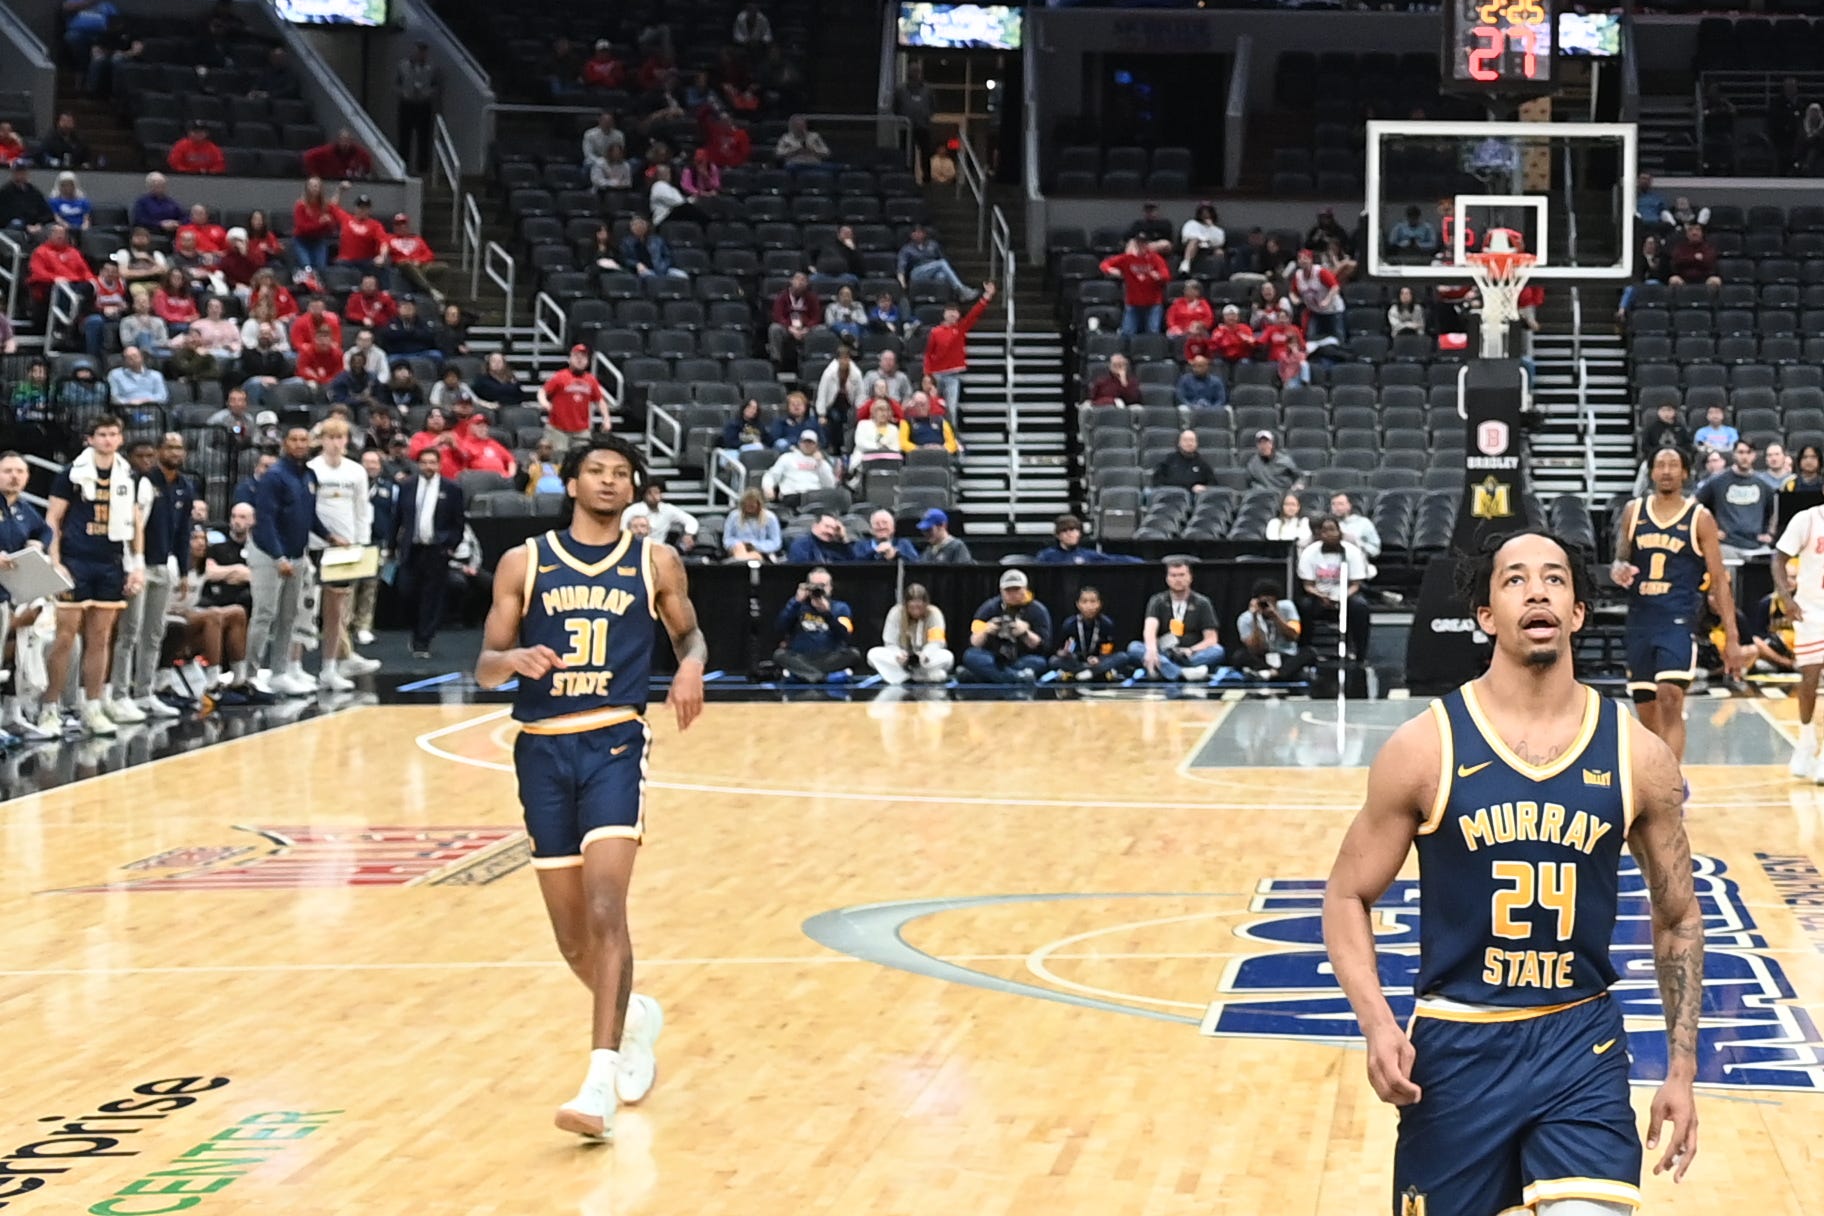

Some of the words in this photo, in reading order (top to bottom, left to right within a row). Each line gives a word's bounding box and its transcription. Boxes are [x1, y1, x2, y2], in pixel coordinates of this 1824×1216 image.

[1468, 26, 1538, 81] 27
[541, 585, 636, 616] MURRAY
[562, 618, 609, 667] 31
[549, 670, 613, 697] STATE
[1457, 800, 1612, 855] MURRAY
[1490, 860, 1578, 941] 24
[1482, 947, 1575, 990] STATE
[0, 1074, 231, 1209] erprise
[88, 1108, 347, 1216] CENTER
